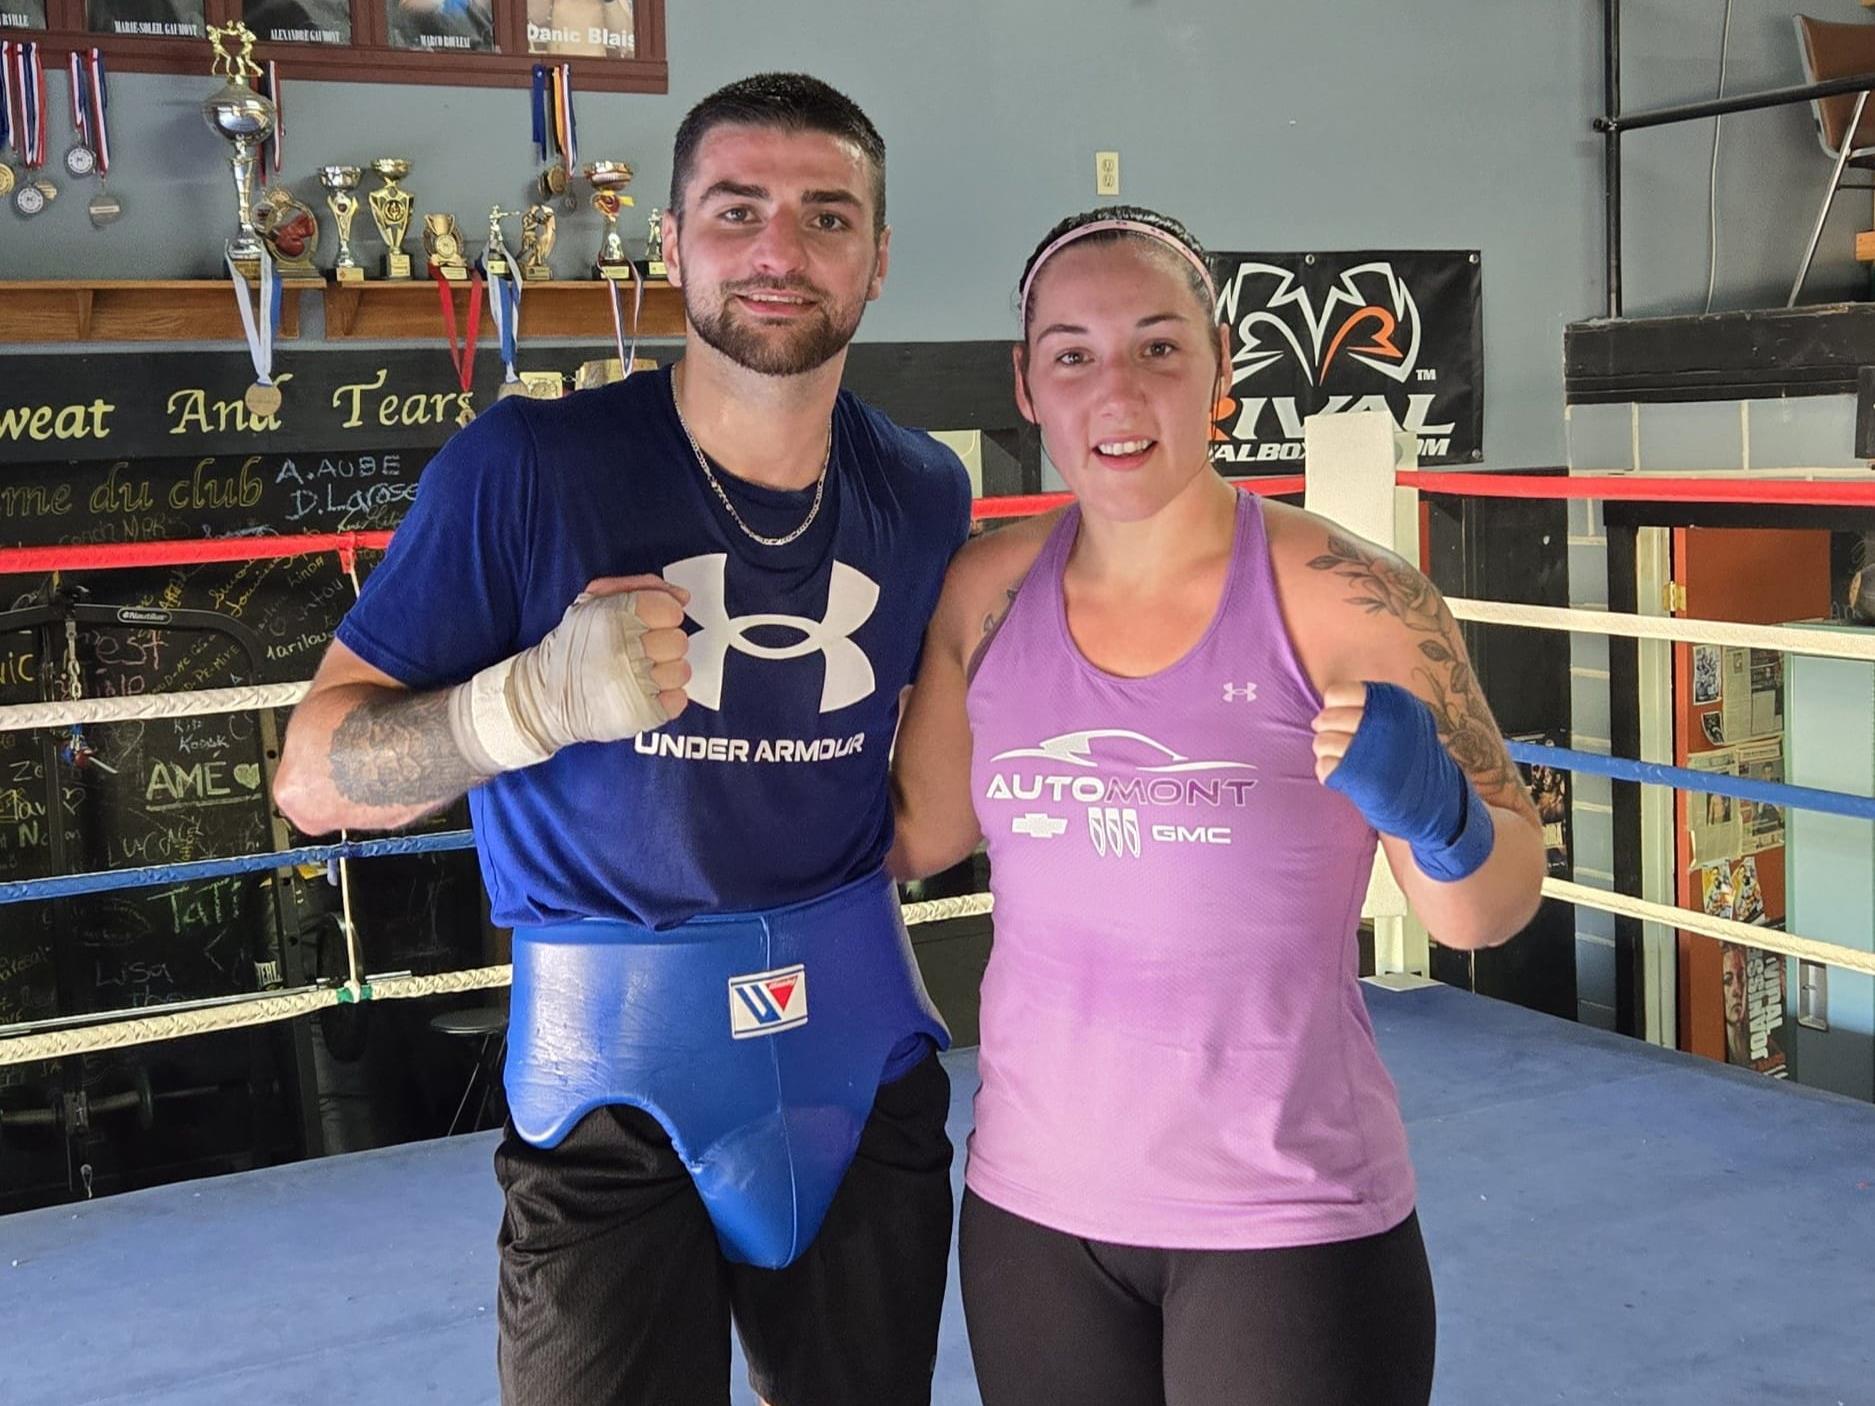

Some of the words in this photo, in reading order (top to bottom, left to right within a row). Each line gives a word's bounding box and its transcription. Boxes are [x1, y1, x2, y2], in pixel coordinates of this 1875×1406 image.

[527, 22, 581, 43] Danic
[588, 27, 634, 48] Blais
[1415, 368, 1437, 381] TM
[88, 461, 154, 514] du
[168, 456, 264, 510] club
[634, 731, 750, 763] UNDER
[753, 732, 866, 763] ARMOUR
[986, 773, 1258, 807] AUTOMONT
[1152, 824, 1232, 844] GMC
